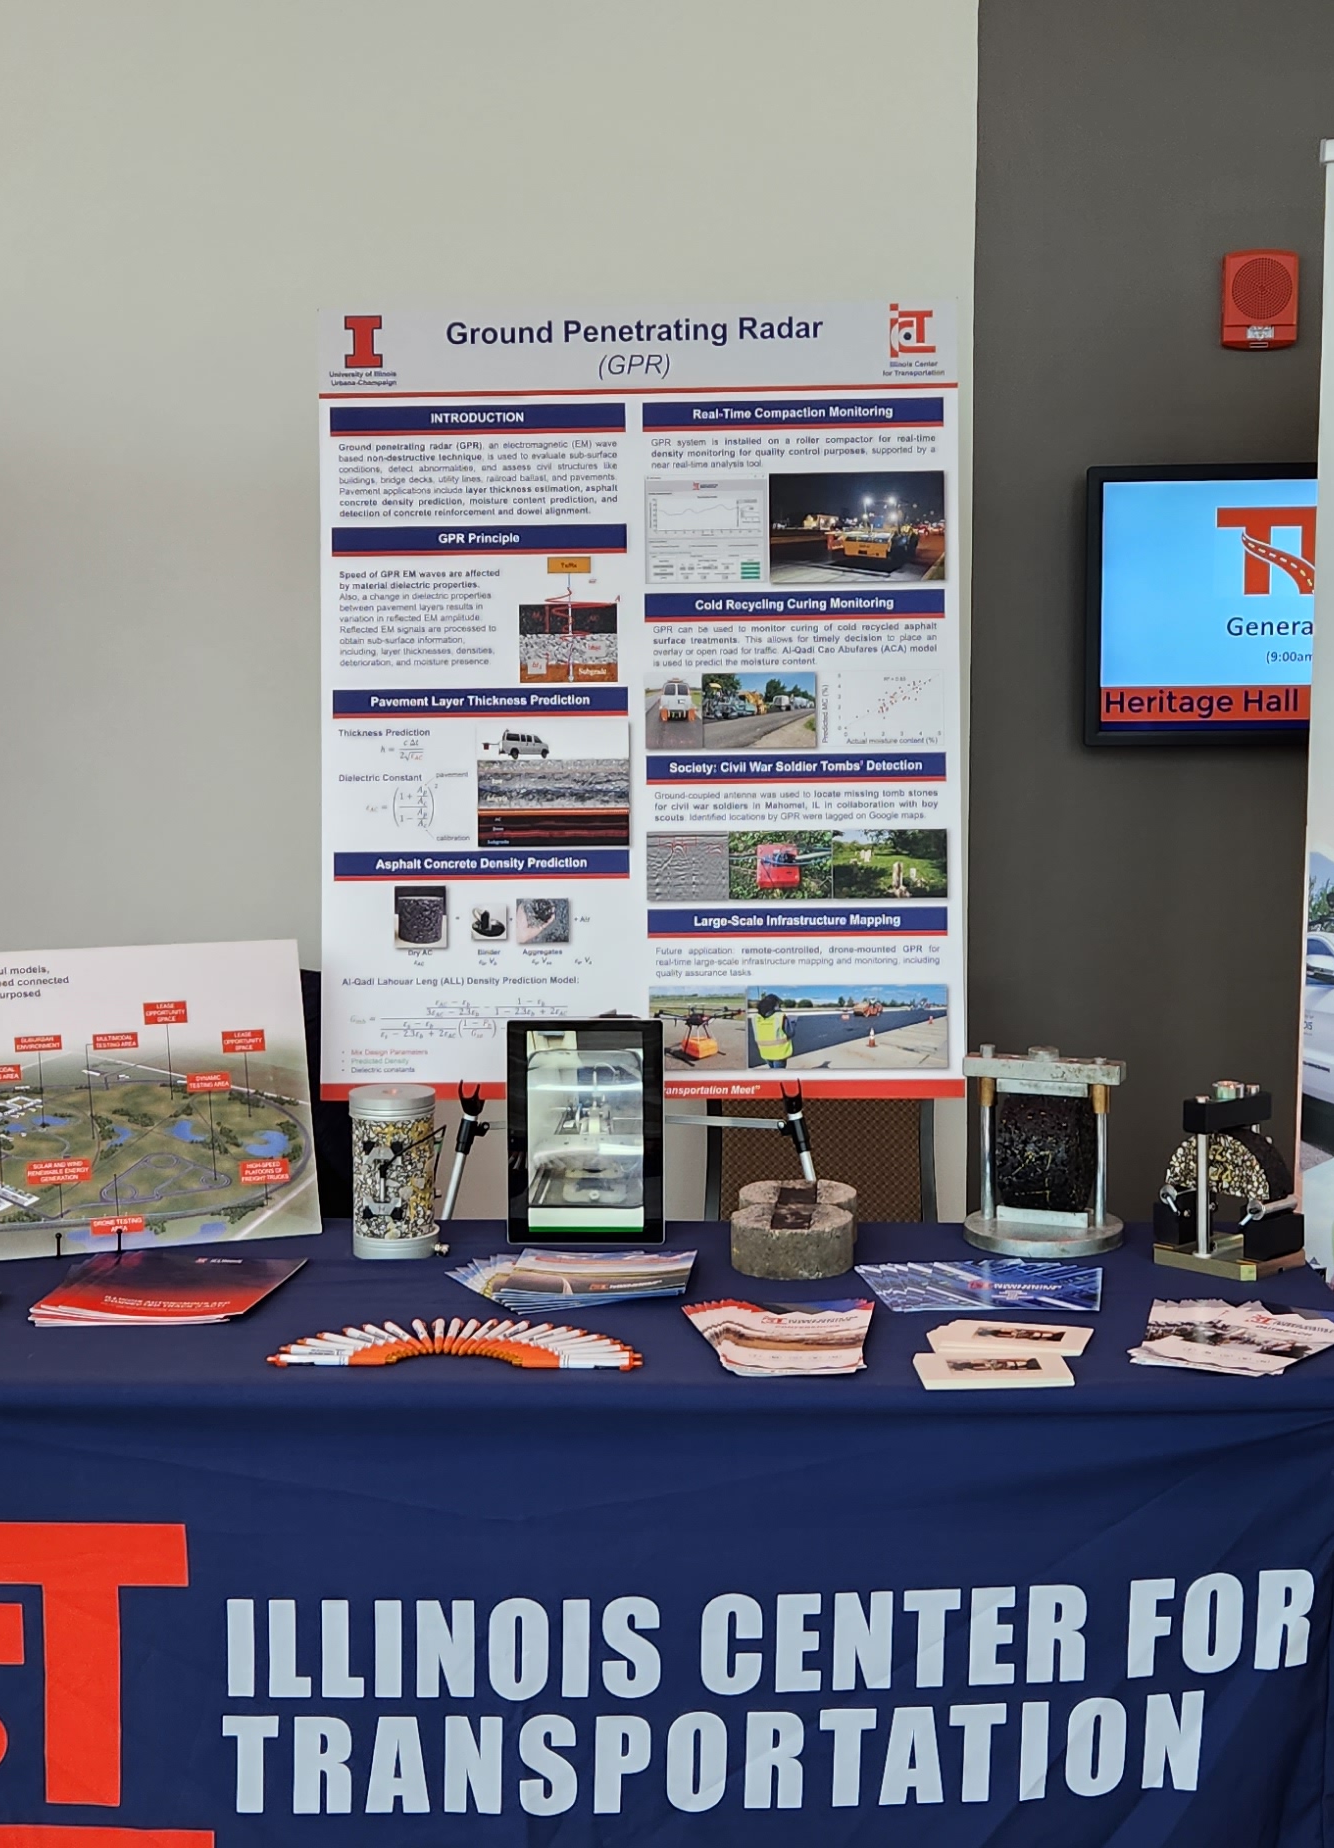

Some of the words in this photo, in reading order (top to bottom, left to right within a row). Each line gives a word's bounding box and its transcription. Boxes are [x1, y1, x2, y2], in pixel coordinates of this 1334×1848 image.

[447, 321, 552, 344] Ground
[564, 319, 727, 346] Penetrating
[740, 317, 823, 339] Radar
[599, 354, 669, 380] (GPR)
[755, 407, 825, 420] Compaction
[830, 406, 893, 418] Monitoring
[469, 533, 519, 545] Principle
[726, 599, 784, 612] Recycling
[787, 599, 826, 611] Curing
[830, 597, 893, 610] Monitoring
[432, 696, 464, 708] Layer
[1106, 690, 1233, 718] Heritage
[1244, 689, 1297, 712] Hall
[670, 763, 716, 775] Society:
[376, 859, 421, 871] Asphalt
[481, 858, 524, 870] Density
[694, 915, 763, 928] Large-Scale
[850, 914, 900, 927] Mapping
[224, 1598, 665, 1699] ILLINOIS
[697, 1582, 1090, 1694] CENTER
[1125, 1569, 1316, 1675] FOR
[222, 1691, 1210, 1816] TRANSPORTATION
